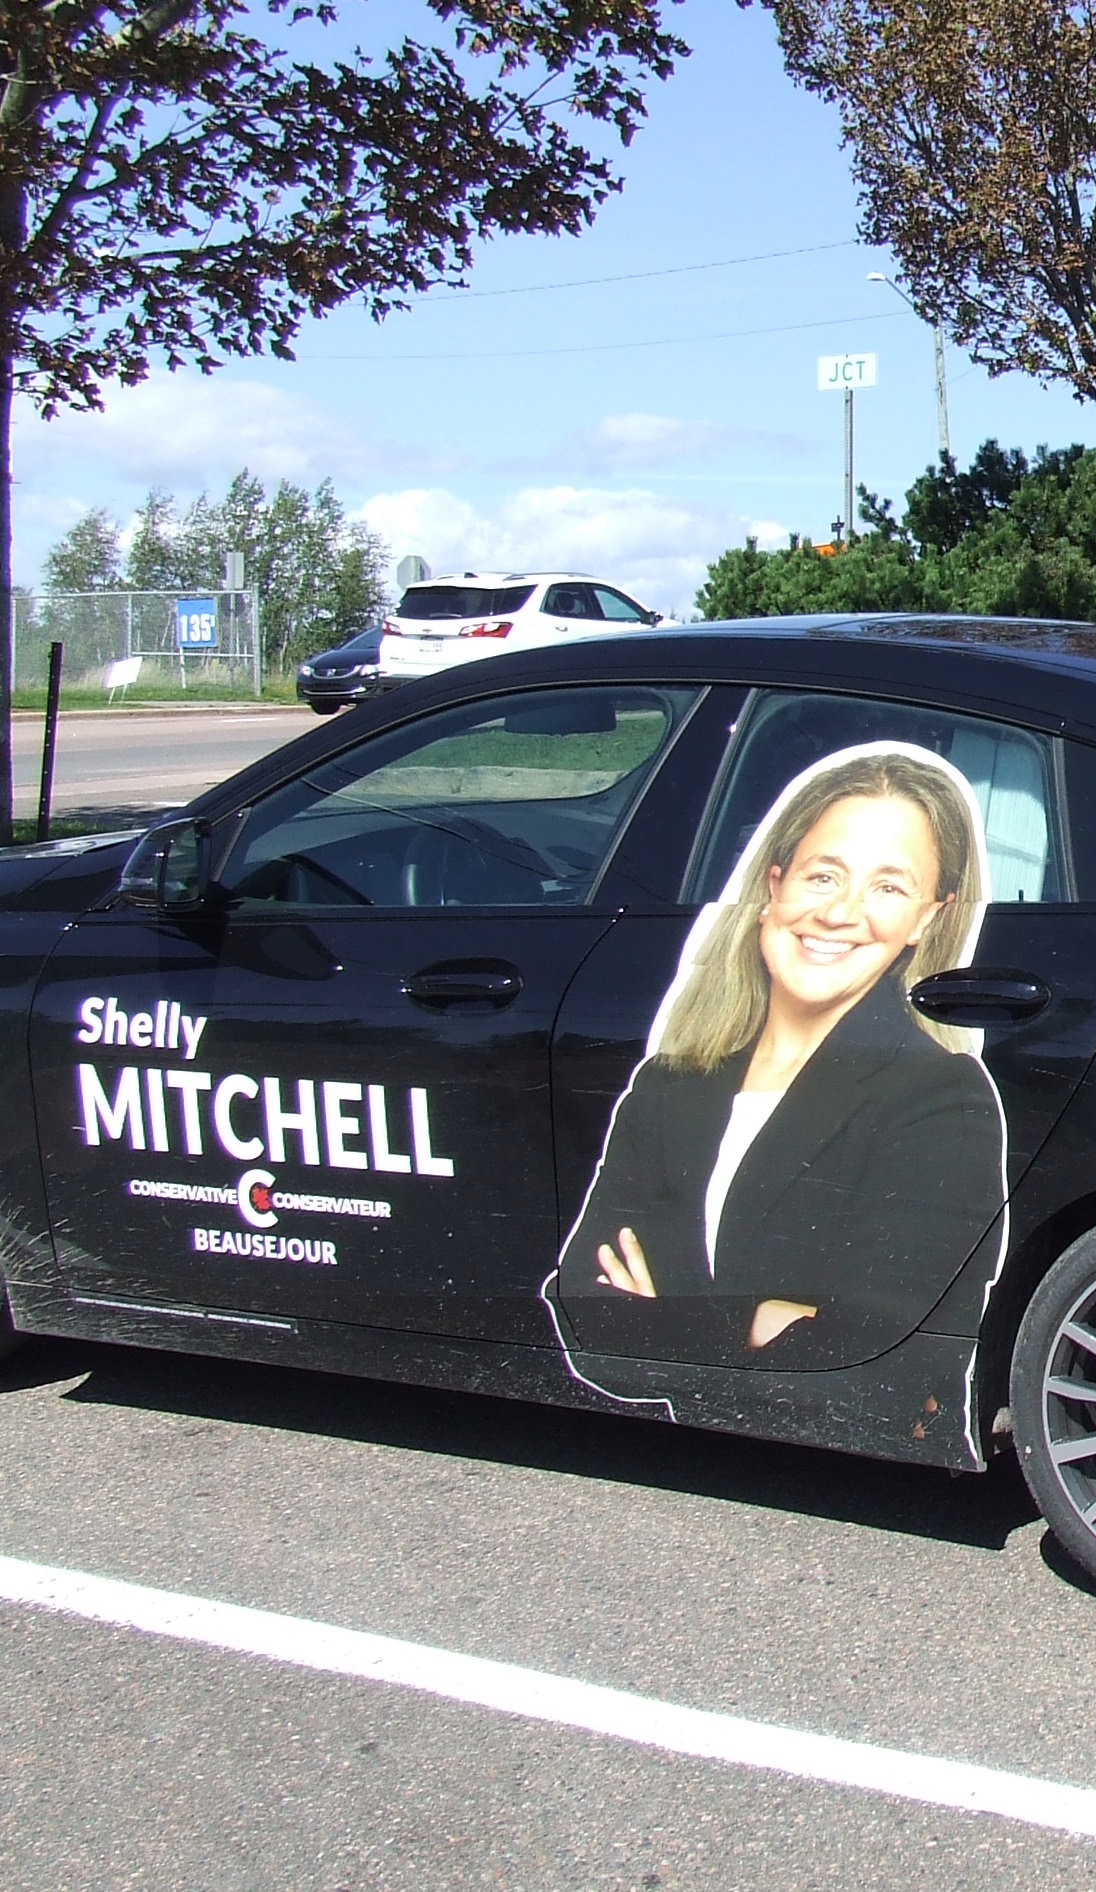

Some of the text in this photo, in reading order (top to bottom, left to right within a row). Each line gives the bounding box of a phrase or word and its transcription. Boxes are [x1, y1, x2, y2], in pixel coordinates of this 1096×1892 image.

[828, 360, 866, 382] JCT
[77, 996, 208, 1060] Shelly
[78, 1063, 455, 1177] MITCHELL
[129, 1179, 239, 1205] CONSERVATIVE
[272, 1191, 392, 1219] CONSERVATEUR
[193, 1227, 338, 1266] BEAUSEJOUR
